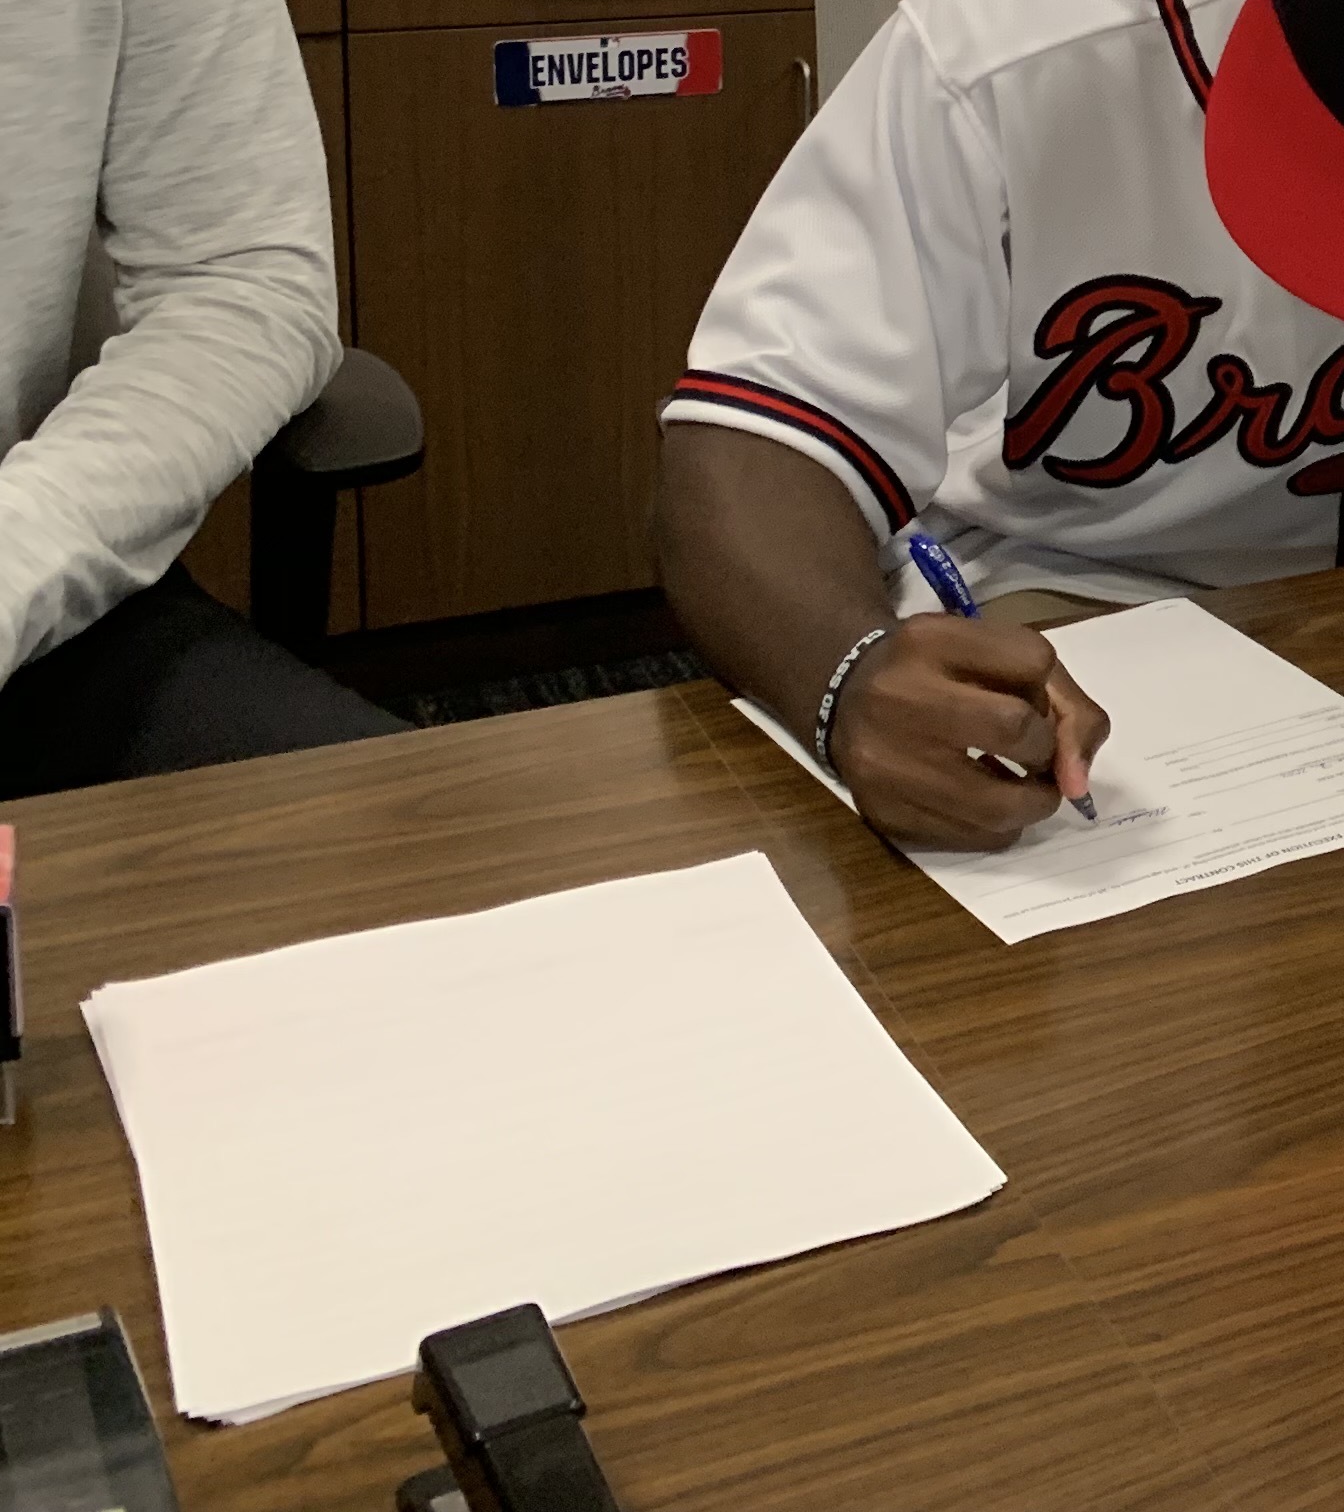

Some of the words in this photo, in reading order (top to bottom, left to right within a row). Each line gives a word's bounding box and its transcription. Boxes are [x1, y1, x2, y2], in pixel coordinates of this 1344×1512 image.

[531, 46, 689, 87] ENVELOPES
[829, 629, 886, 690] CLASS
[818, 693, 834, 723] OF
[1174, 865, 1236, 886] CONTRACT
[1238, 856, 1263, 869] THIS
